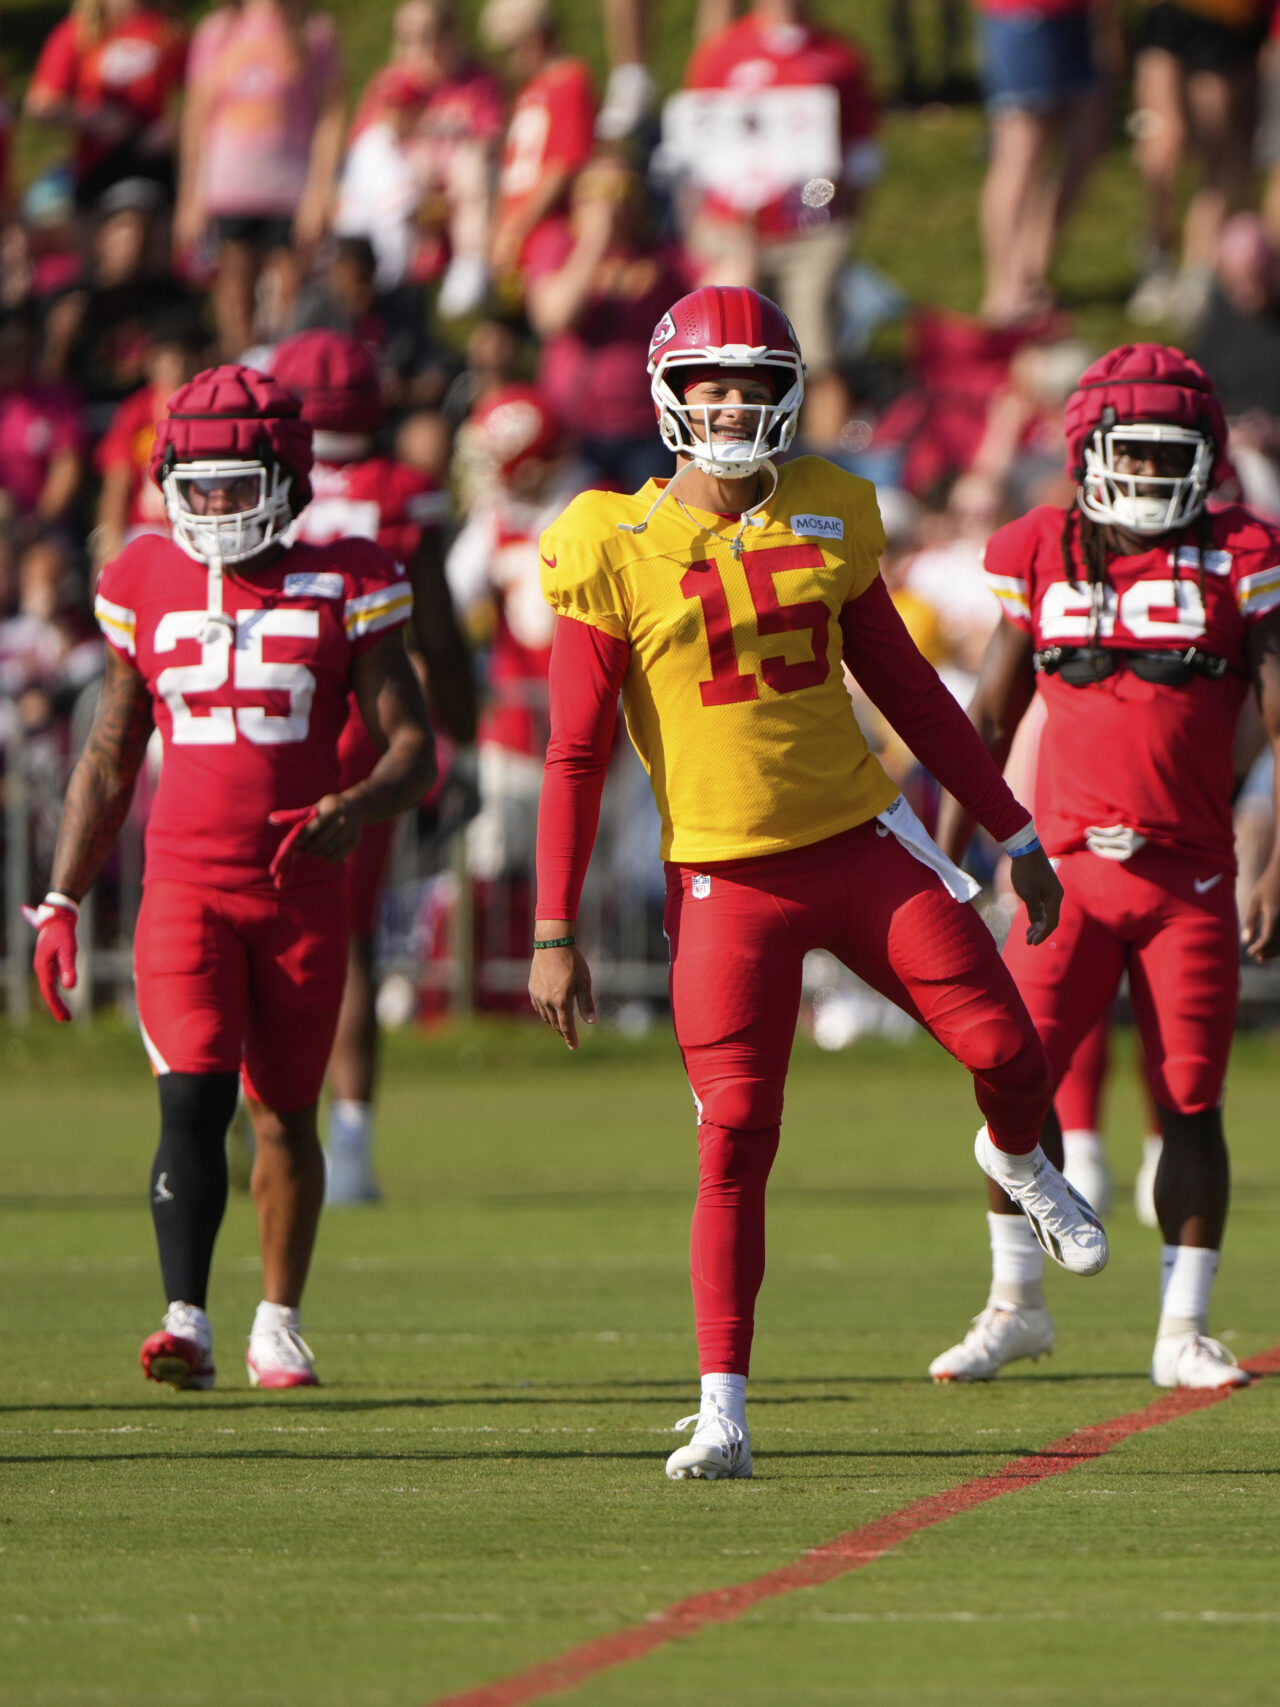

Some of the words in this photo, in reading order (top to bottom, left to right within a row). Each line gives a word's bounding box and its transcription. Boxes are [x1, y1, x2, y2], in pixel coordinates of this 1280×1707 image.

[796, 518, 842, 532] MOSAIC
[154, 609, 319, 744] 25
[680, 543, 832, 707] 15
